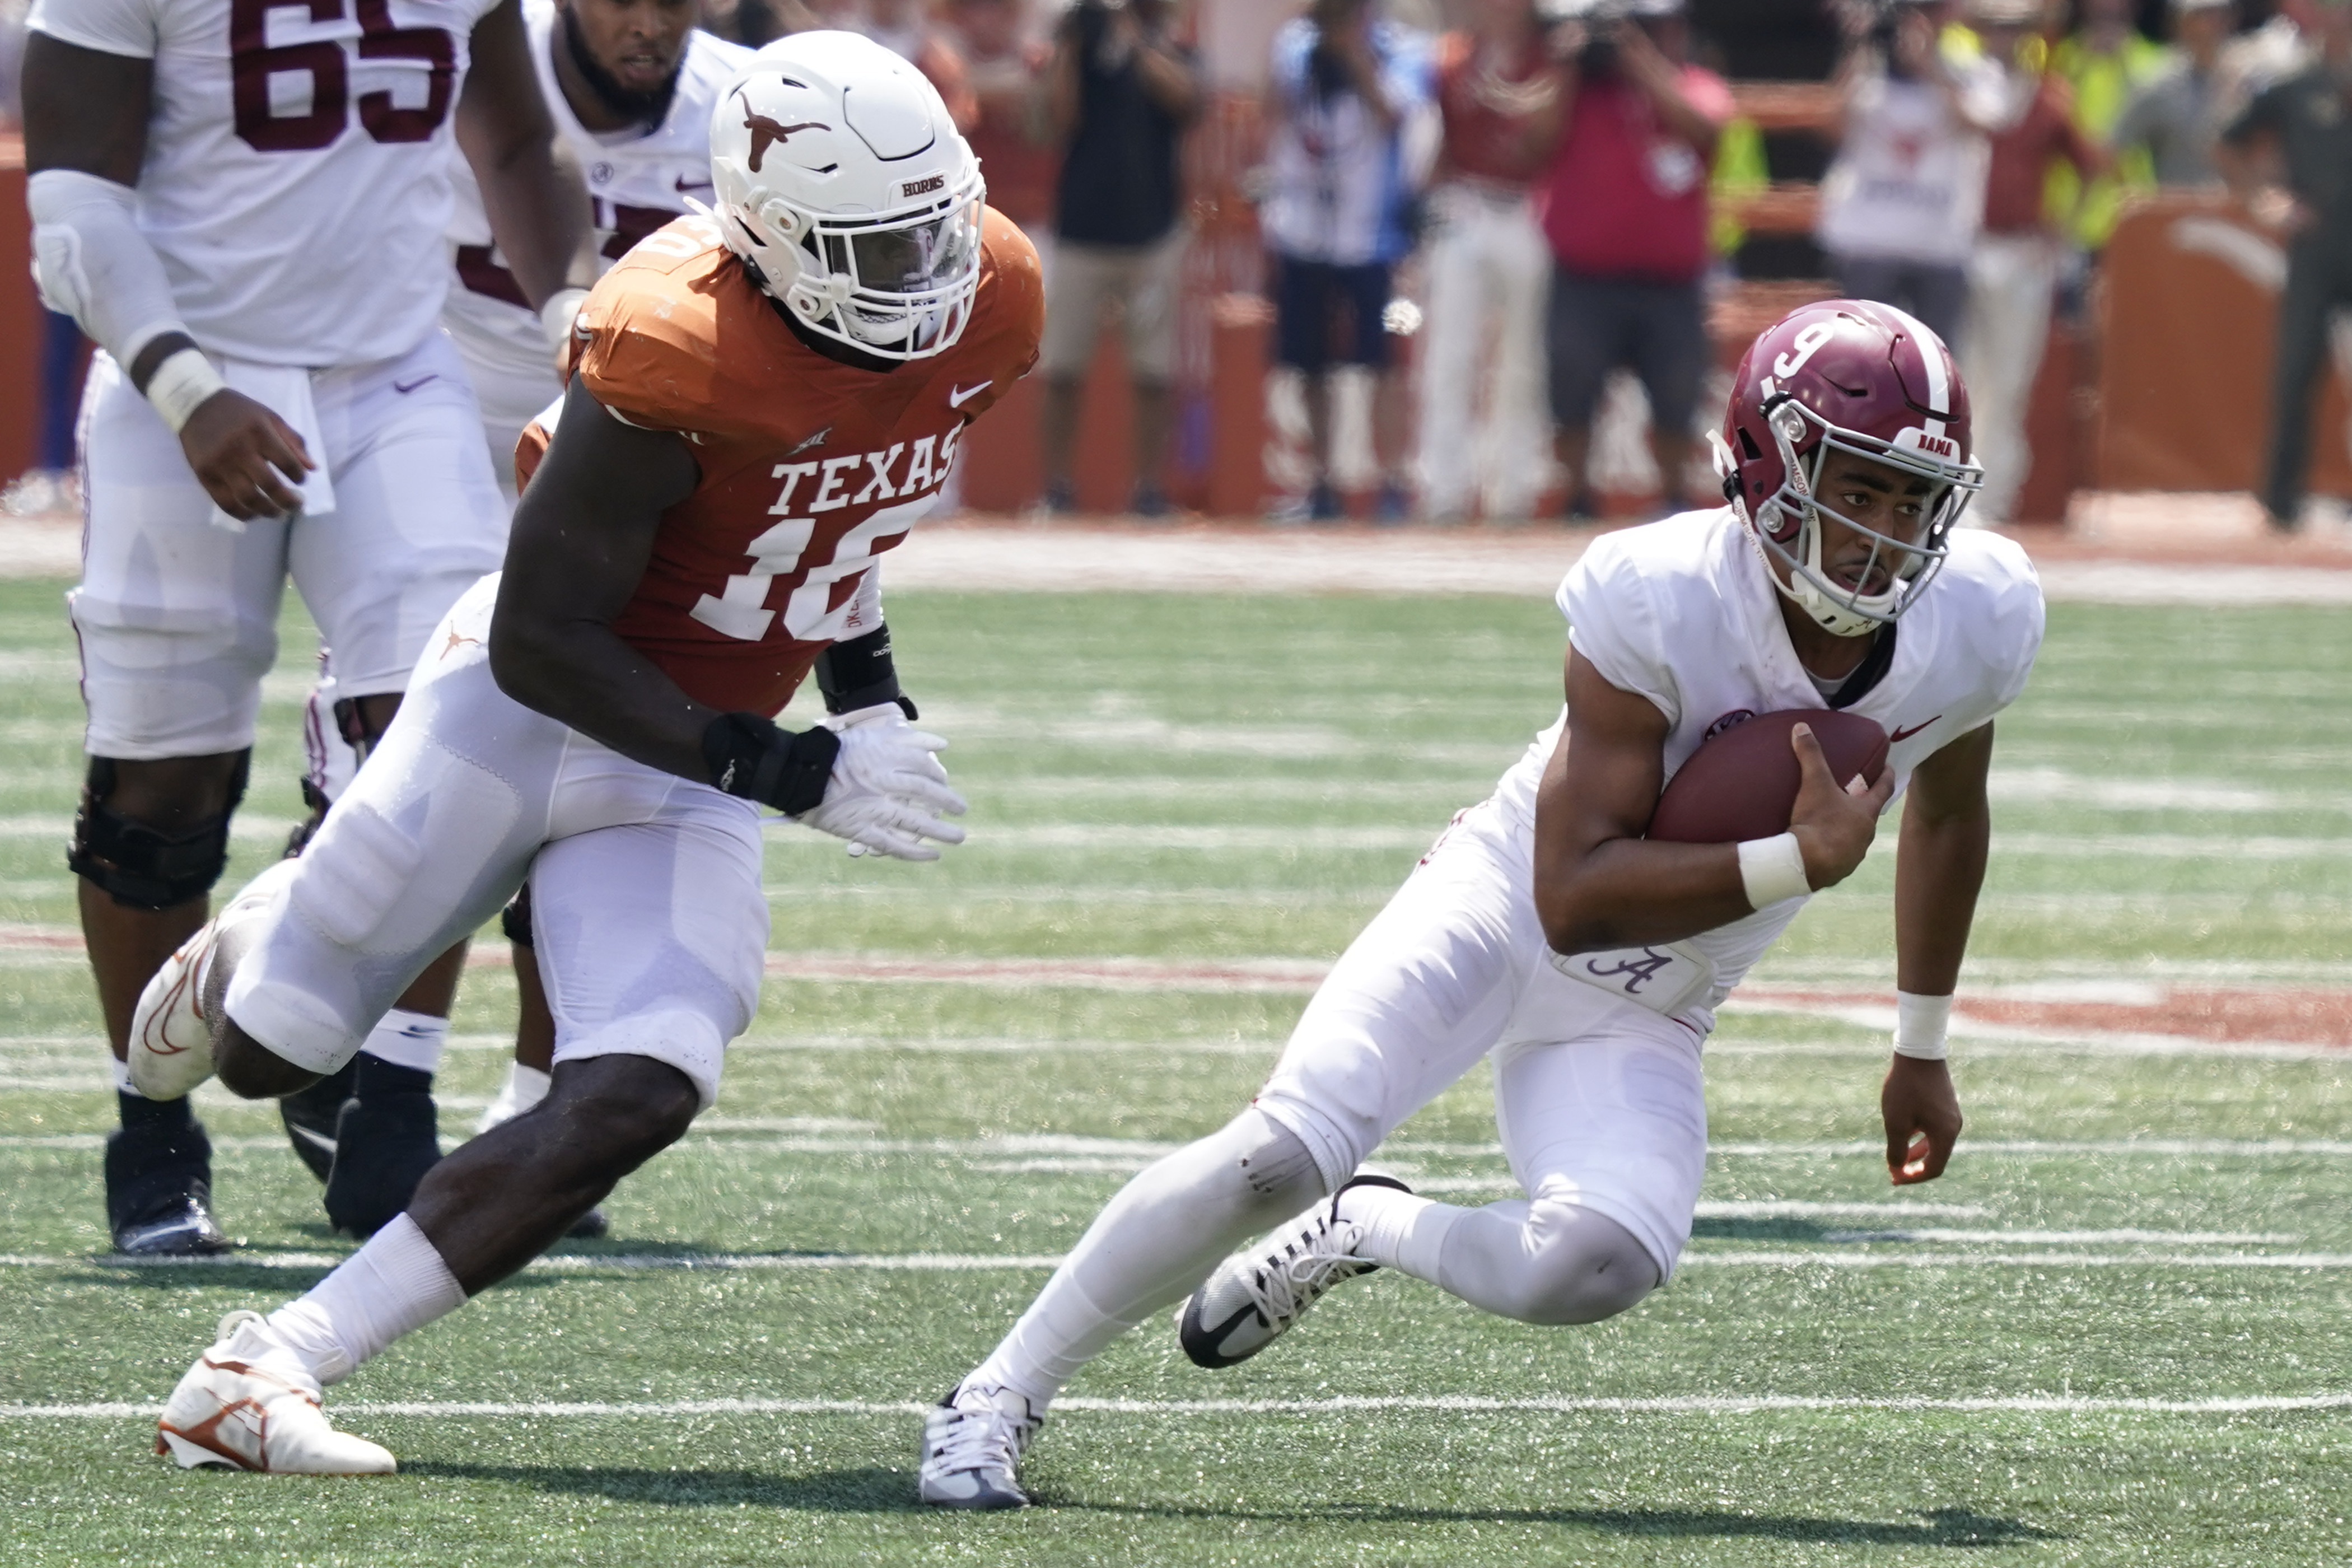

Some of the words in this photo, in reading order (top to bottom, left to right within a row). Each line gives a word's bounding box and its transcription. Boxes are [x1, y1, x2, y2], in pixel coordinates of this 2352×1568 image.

[231, 0, 457, 151] 65
[902, 175, 944, 197] HORNS
[1774, 322, 1834, 379] 9
[768, 419, 964, 515] TEXAS
[1917, 434, 1953, 456] BAMA
